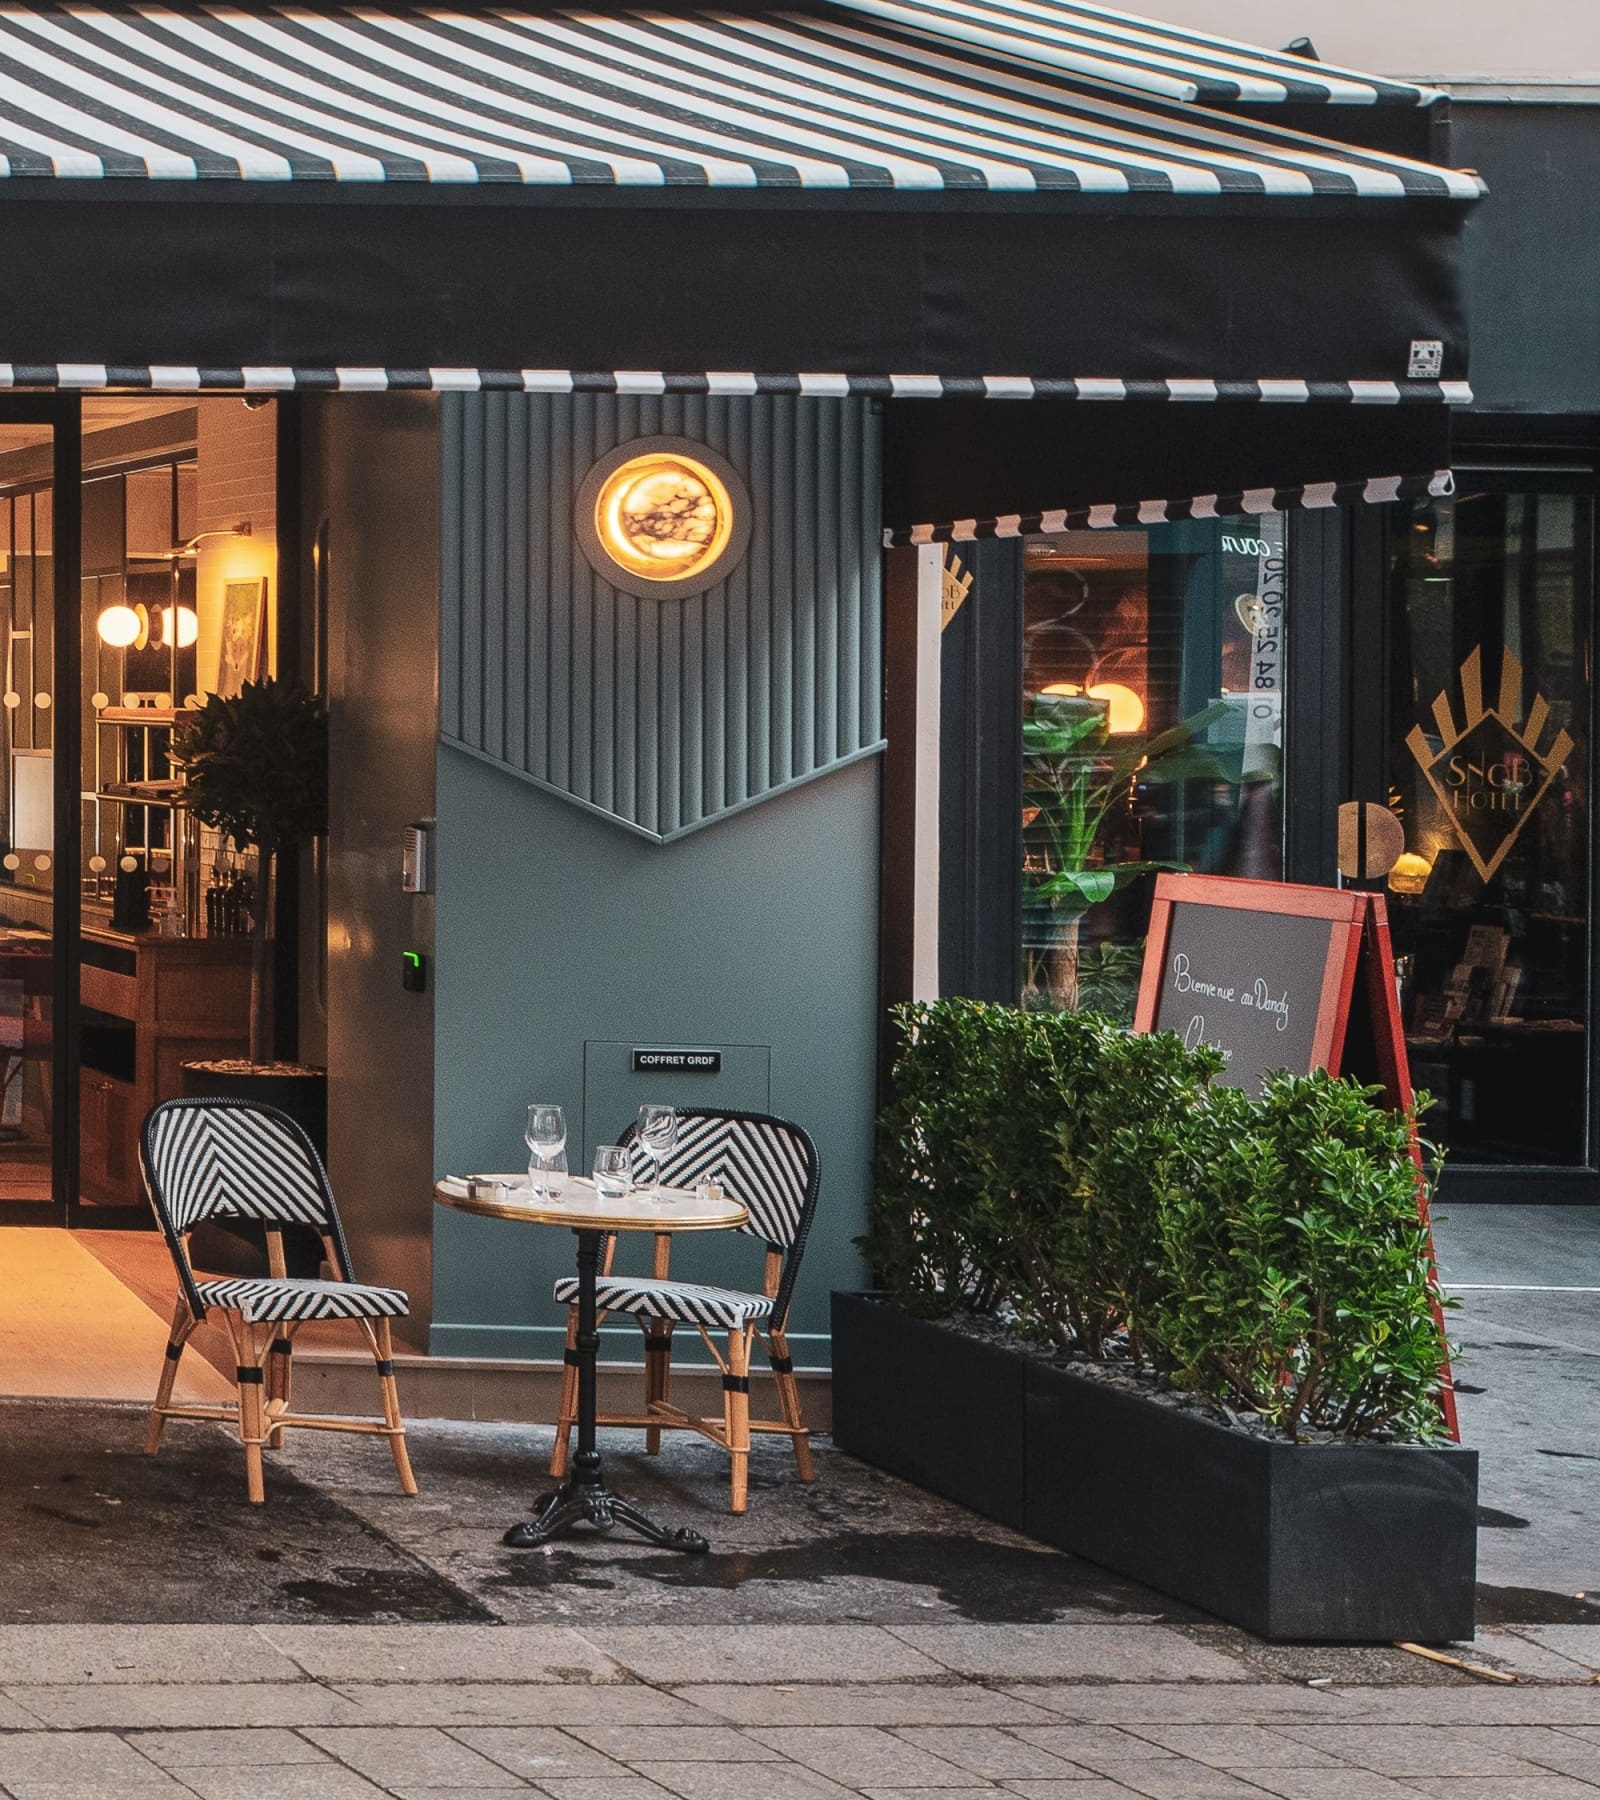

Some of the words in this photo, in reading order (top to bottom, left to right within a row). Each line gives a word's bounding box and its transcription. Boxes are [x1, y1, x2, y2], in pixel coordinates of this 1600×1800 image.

[1446, 752, 1533, 790] SNOB
[1173, 953, 1235, 1002] Bienvenue
[1240, 991, 1254, 1006] au
[1254, 977, 1289, 1031] Dandy
[640, 1055, 685, 1065] COFFRET
[687, 1056, 715, 1065] GRDF
